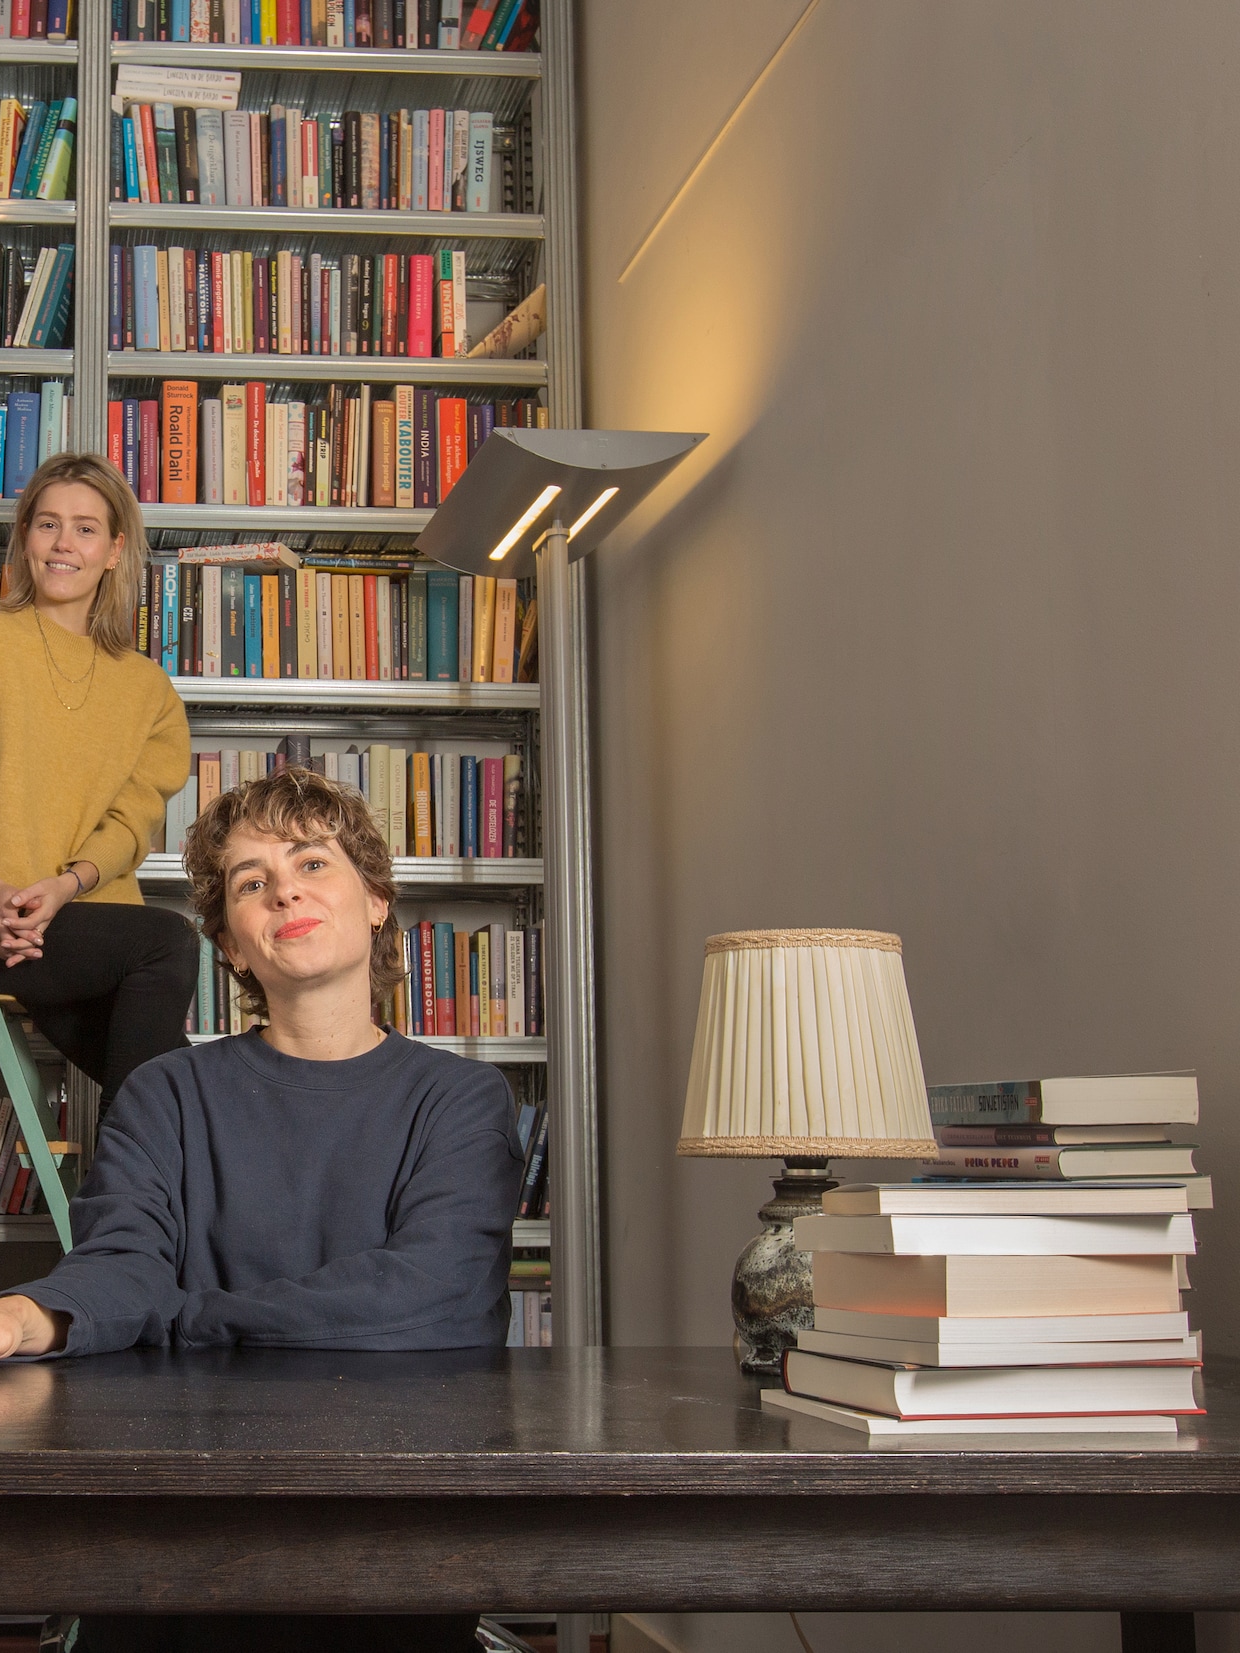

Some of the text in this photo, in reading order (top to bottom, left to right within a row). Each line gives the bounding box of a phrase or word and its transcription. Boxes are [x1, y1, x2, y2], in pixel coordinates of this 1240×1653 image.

[166, 70, 223, 82] LINCOLN IN DE BARDO
[474, 140, 485, 183] IJSWEG
[214, 280, 224, 318] Sorgdrager
[443, 283, 452, 331] VINTAGE
[398, 390, 406, 420] LOUTER
[169, 405, 183, 482] Roald Dahl
[399, 420, 412, 489] KABOUTER
[420, 430, 430, 458] INDIA
[165, 565, 177, 608] BOT
[139, 606, 148, 651] WACHTWOORD
[183, 607, 193, 622] CEL
[392, 810, 405, 831] Nora
[416, 790, 428, 837] BROOKLYN
[489, 799, 497, 844] DE RUSTELOZEN
[423, 950, 434, 1016] UNDERDOG
[978, 1094, 1019, 1111] SOVJETISTAN
[964, 1157, 1019, 1168] PRINS PEPER
